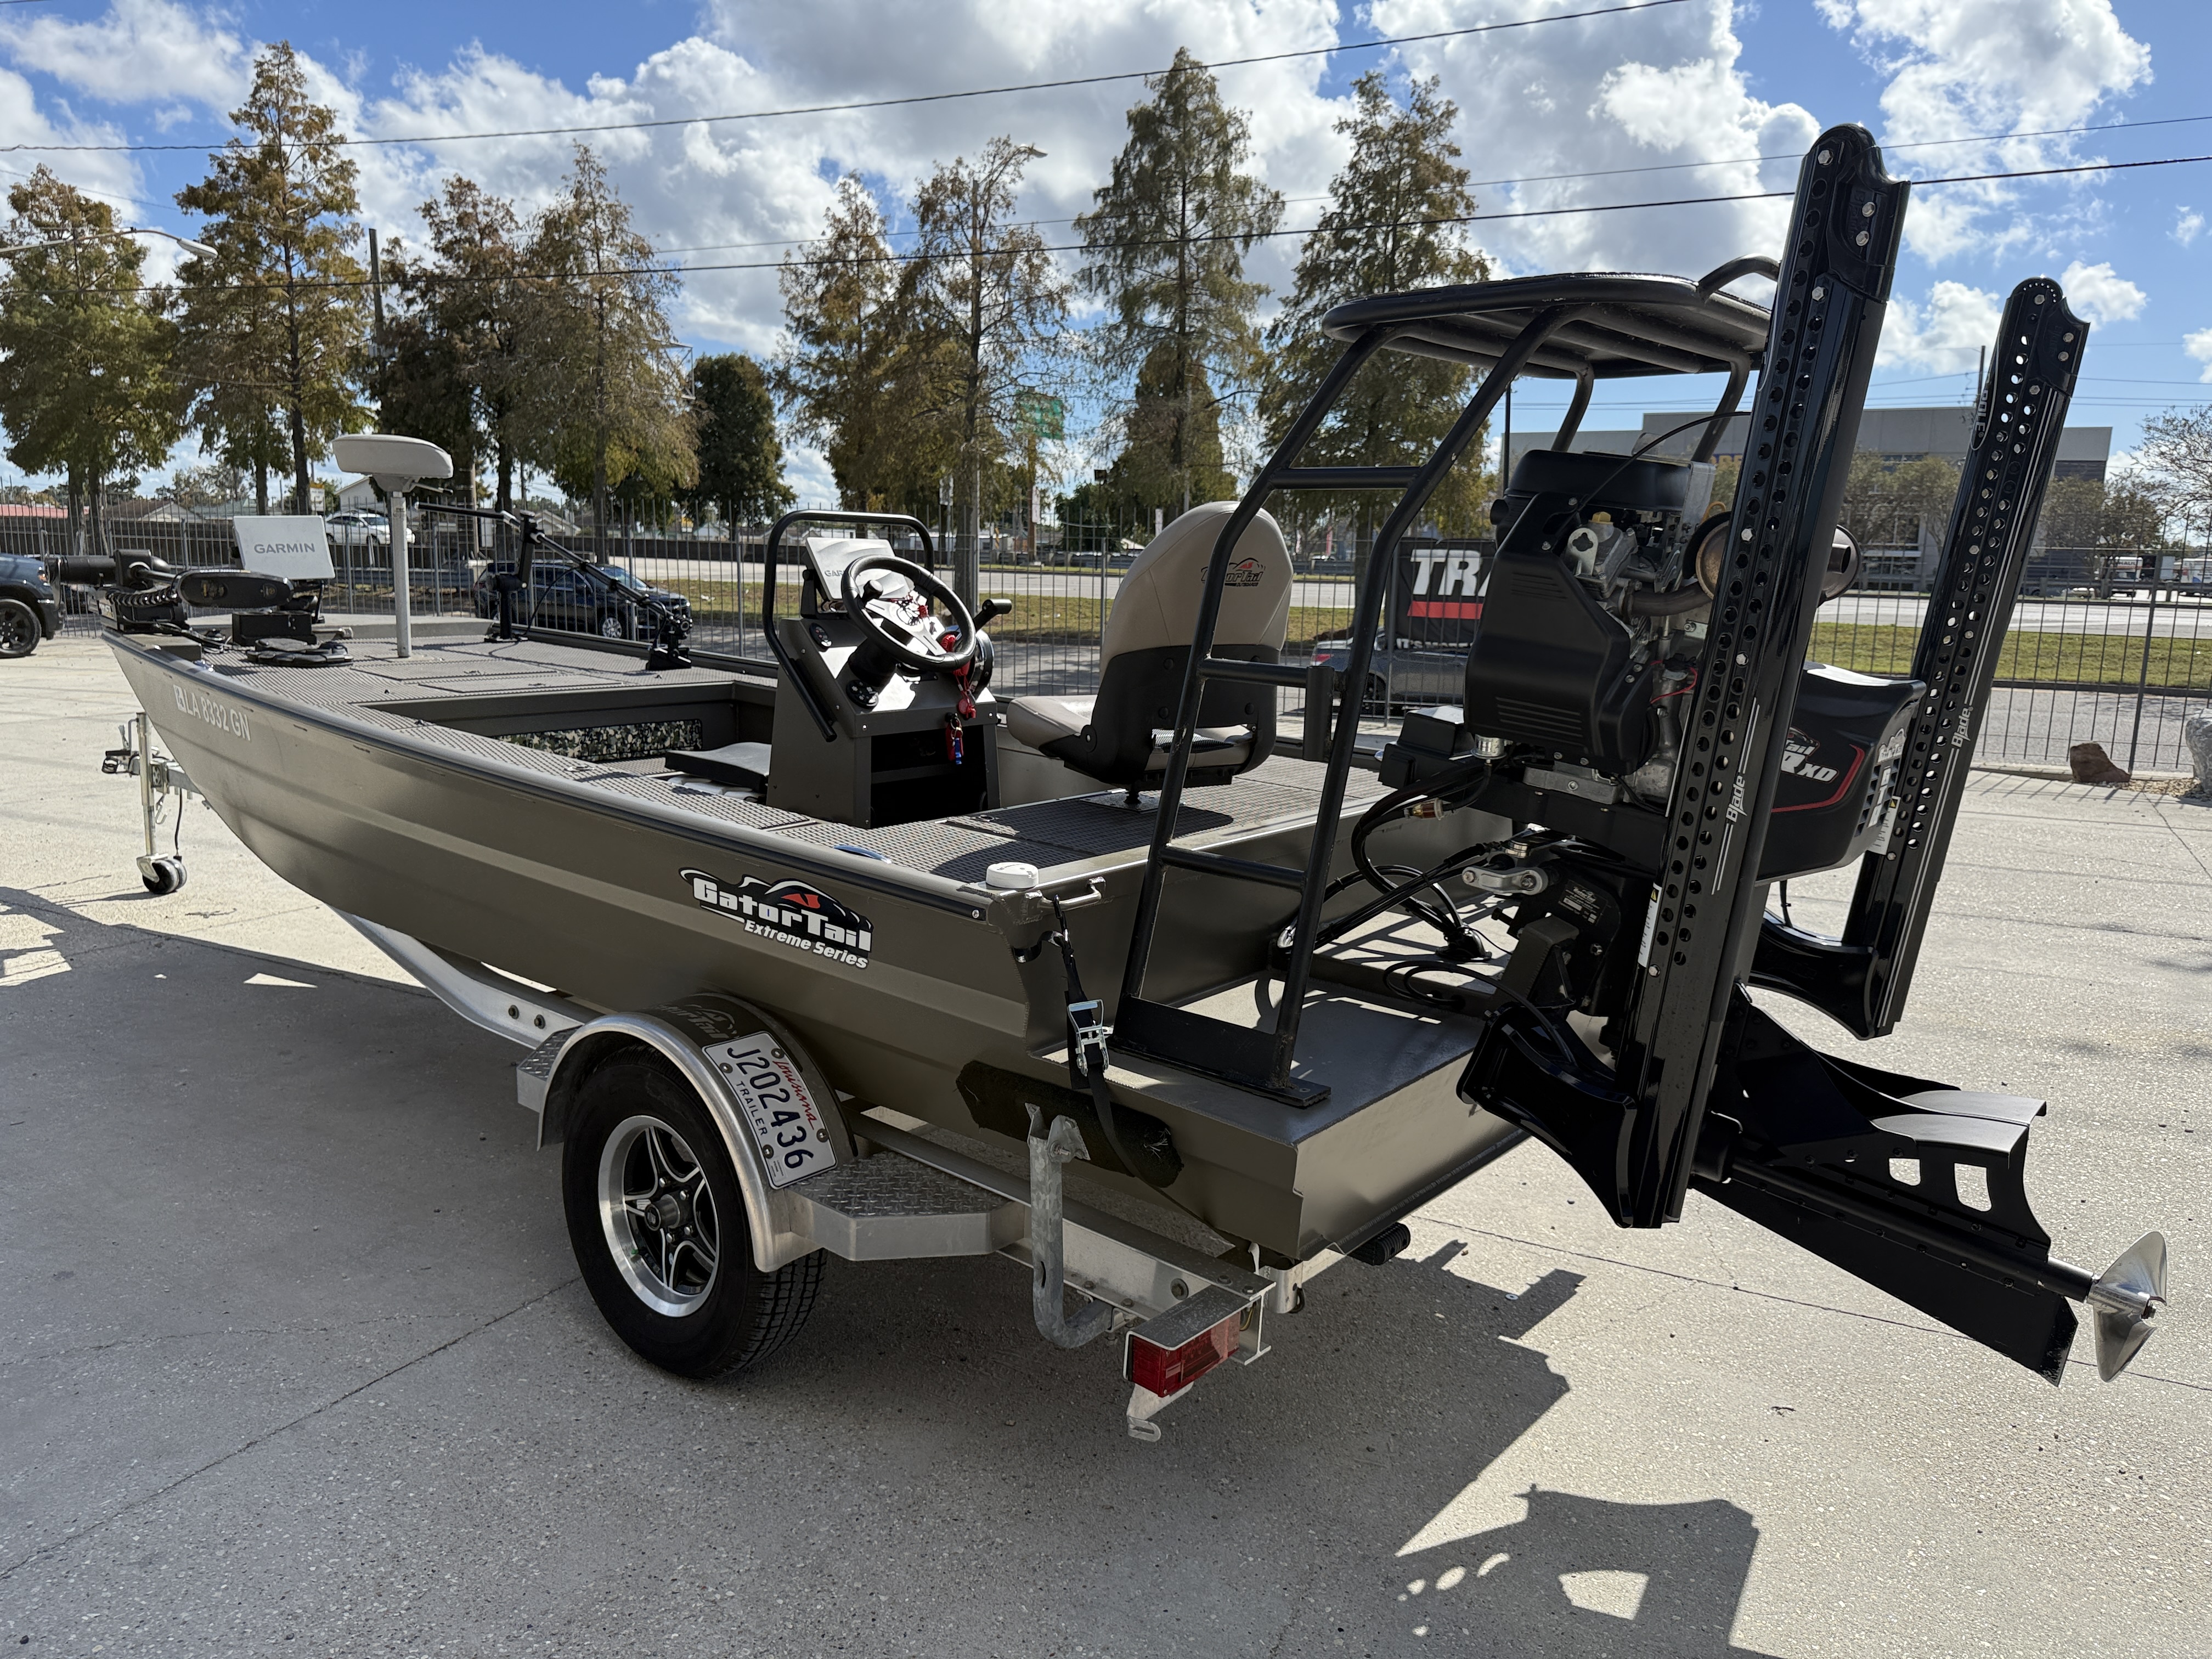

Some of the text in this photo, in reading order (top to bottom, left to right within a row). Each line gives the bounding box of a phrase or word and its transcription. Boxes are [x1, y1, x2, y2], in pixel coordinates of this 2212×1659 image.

[253, 543, 315, 554] GARMIN
[183, 689, 201, 719] LA
[200, 696, 230, 732] 8332
[230, 708, 251, 741] GN
[1951, 708, 1971, 748] Blade
[1725, 775, 1748, 822] Blade
[693, 878, 872, 951] GatorTail
[744, 919, 868, 968] Extreme Series
[727, 1047, 814, 1169] J202436
[736, 1080, 768, 1136] TRAILER
[772, 1060, 817, 1130] Louisiana
